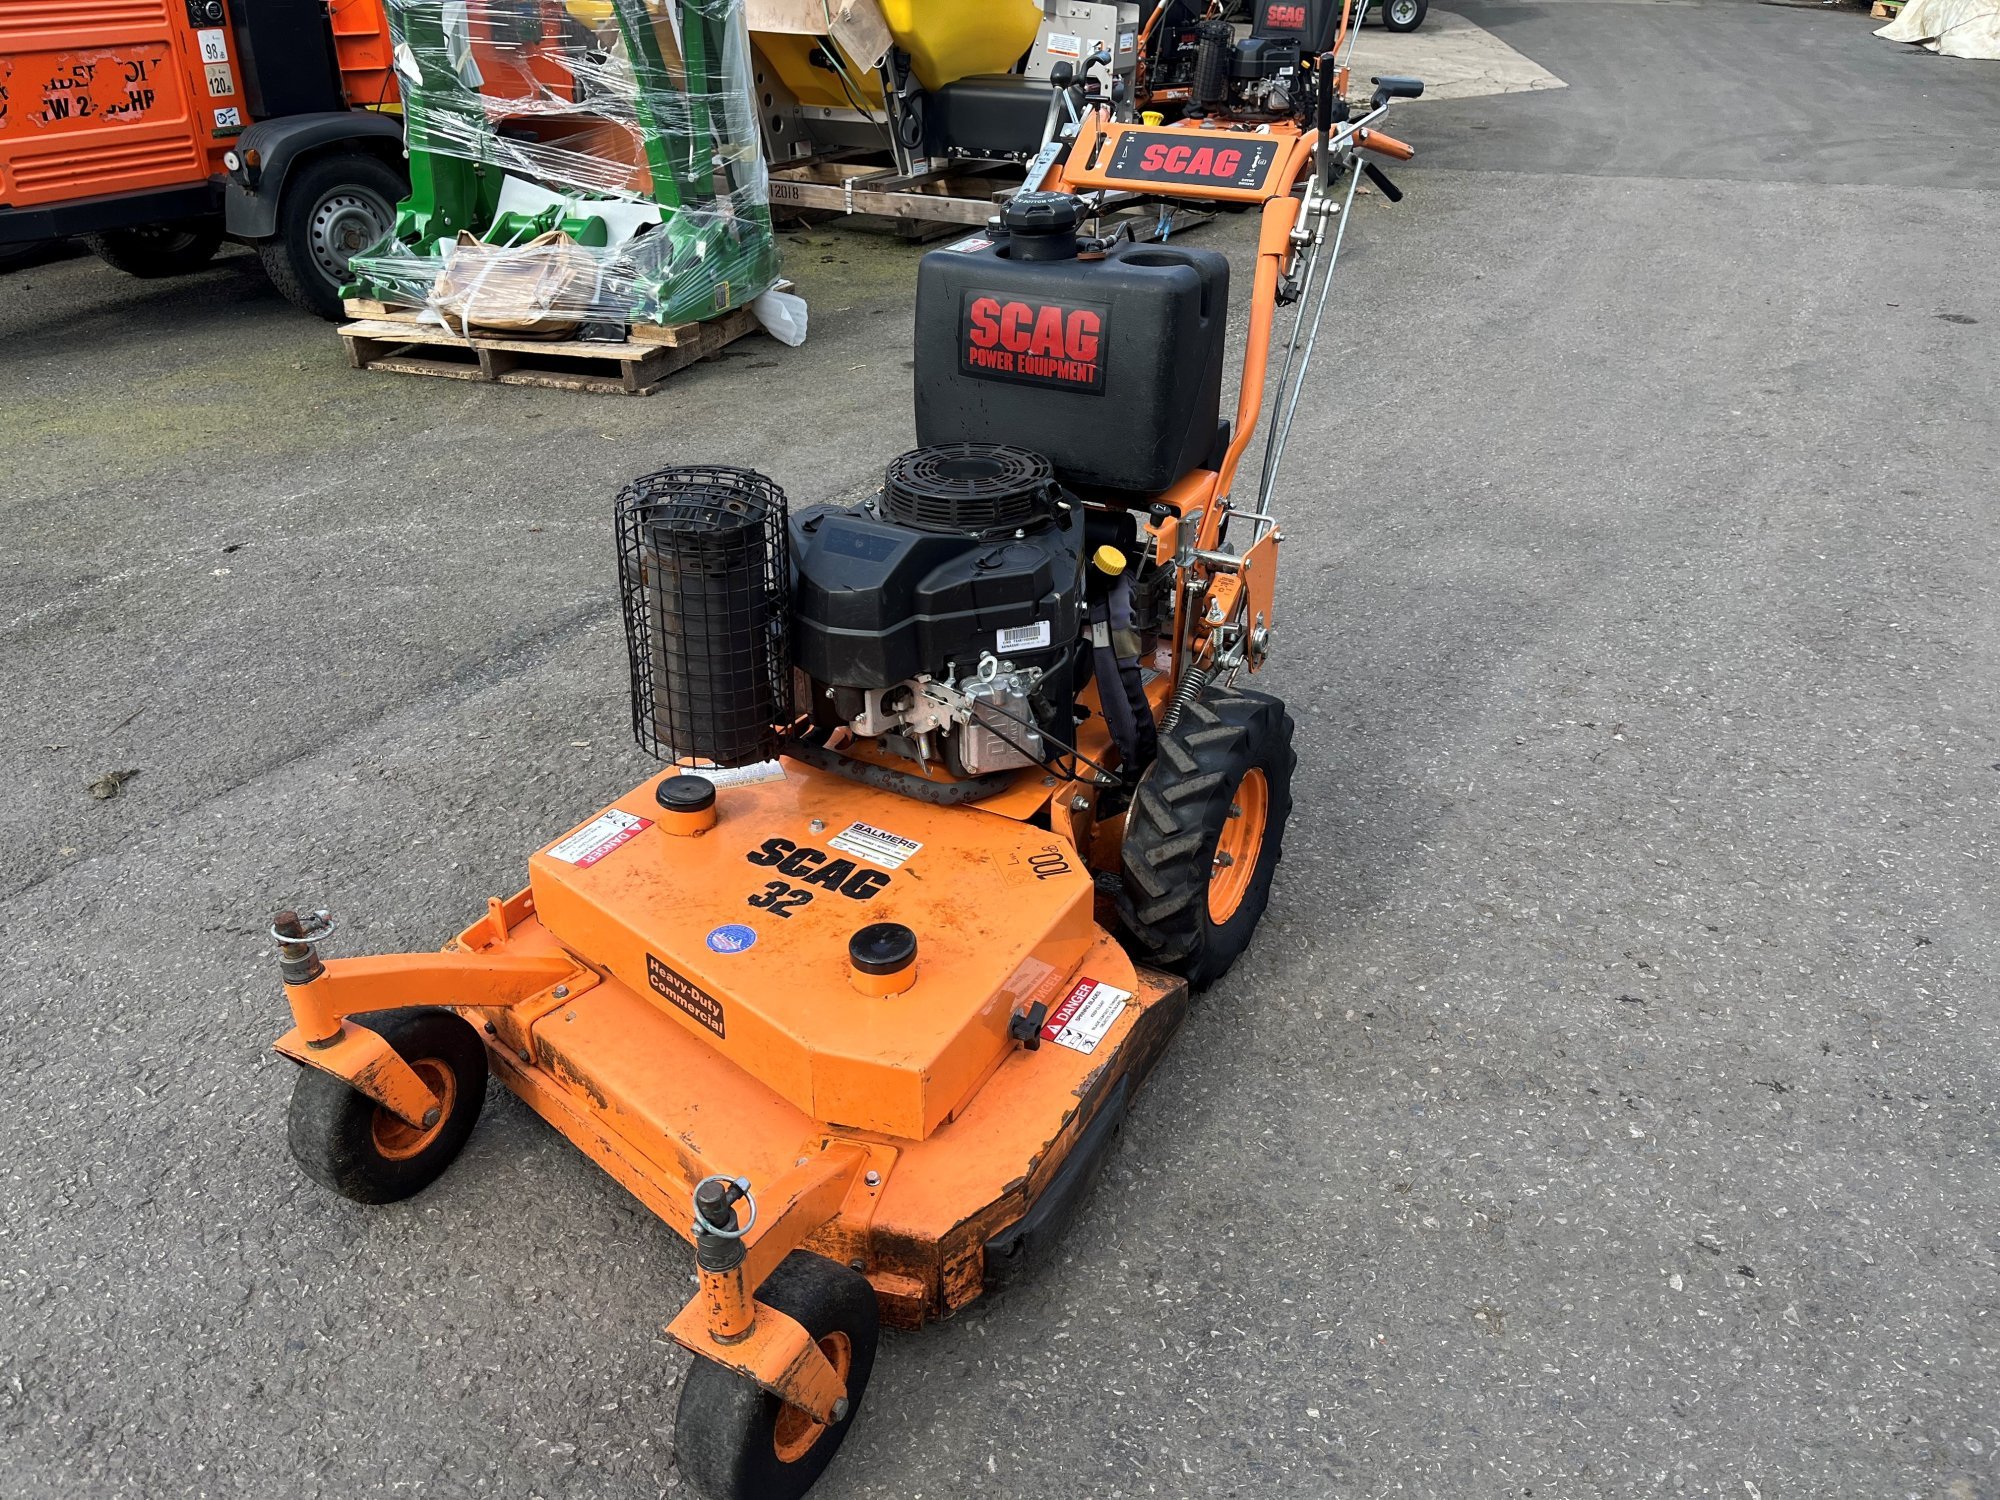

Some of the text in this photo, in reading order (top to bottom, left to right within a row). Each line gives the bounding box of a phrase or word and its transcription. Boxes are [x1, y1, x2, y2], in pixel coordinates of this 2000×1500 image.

[1267, 5, 1305, 21] SCAG
[205, 43, 219, 60] 98
[209, 77, 226, 94] 120
[1139, 144, 1242, 178] SCAG
[970, 297, 1101, 361] SCAG
[969, 346, 1096, 383] POWER EQUIPMENT
[715, 779, 755, 790] WARNIN
[583, 832, 631, 863] DANGER
[852, 823, 919, 850] BALMERS
[745, 838, 892, 900] SCAG
[1027, 853, 1072, 880] 100
[747, 881, 814, 919] 32
[650, 959, 720, 1017] Heavy-Duty
[650, 974, 723, 1034] Commercial
[1056, 983, 1093, 1022] DANGER
